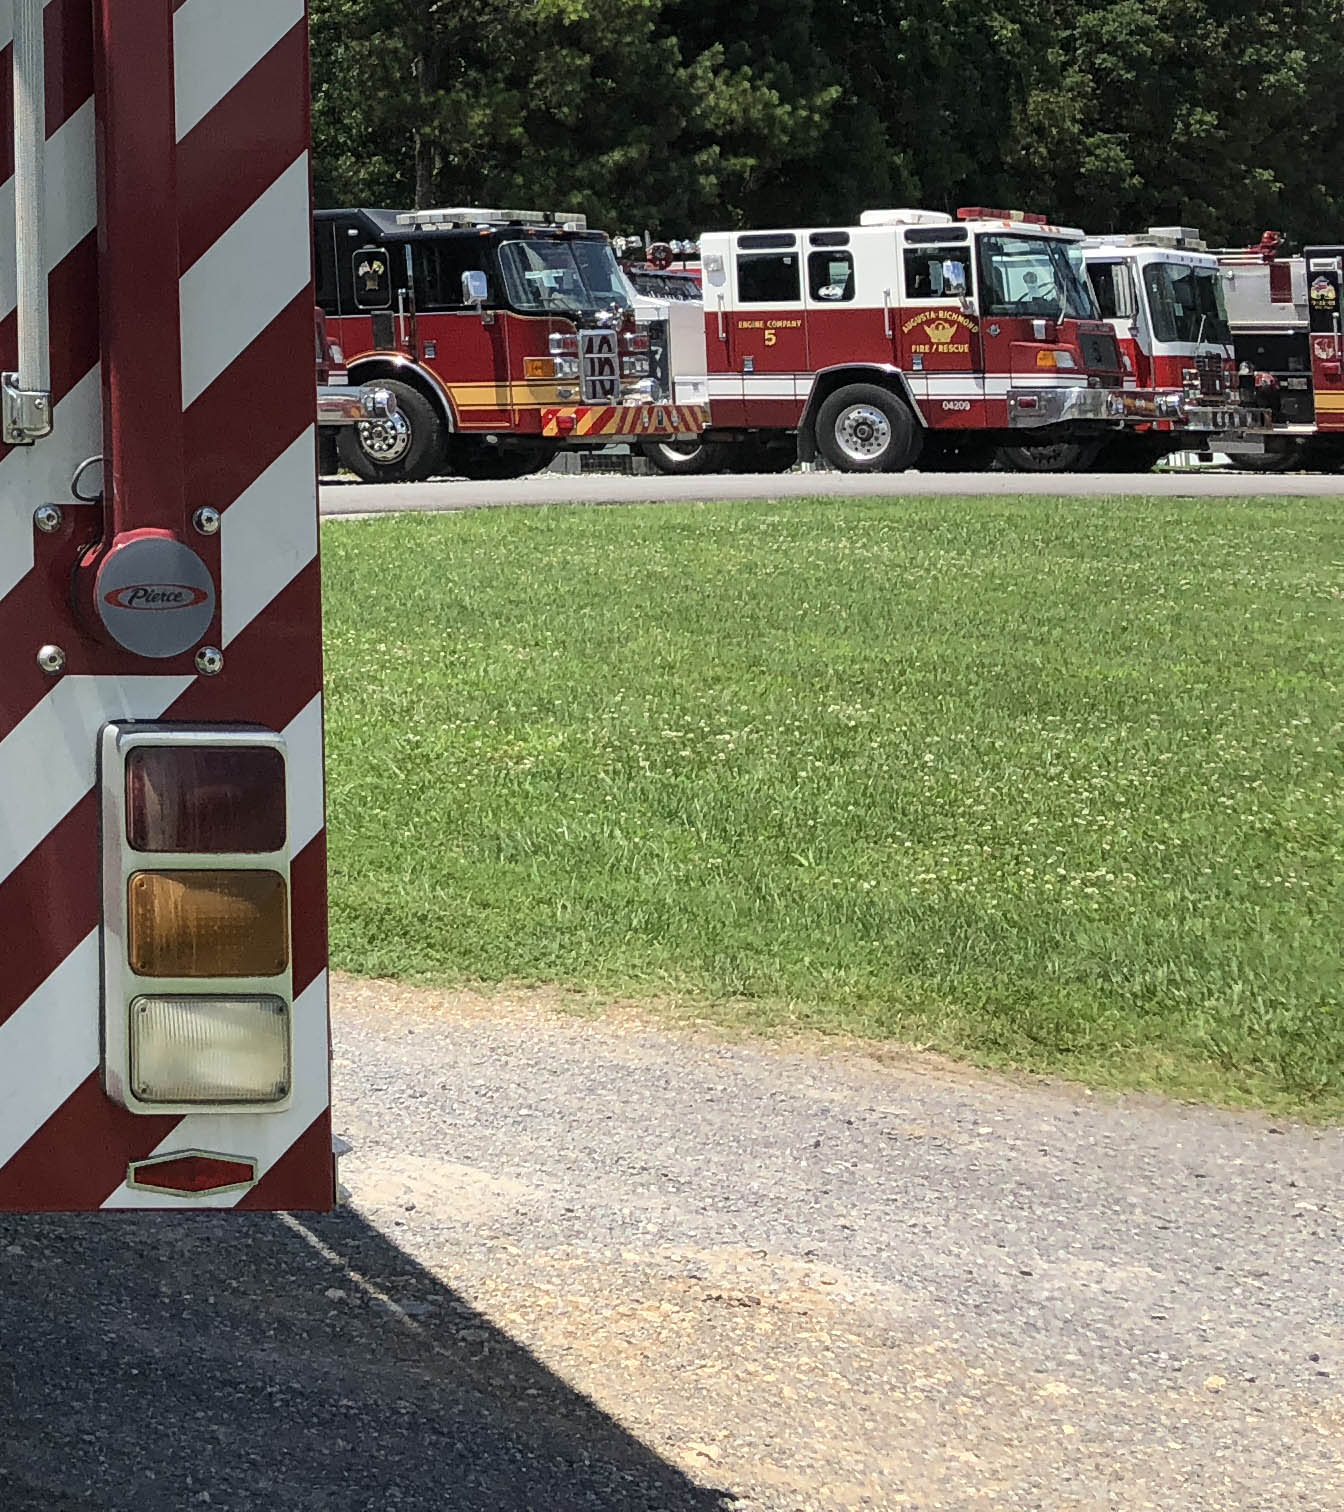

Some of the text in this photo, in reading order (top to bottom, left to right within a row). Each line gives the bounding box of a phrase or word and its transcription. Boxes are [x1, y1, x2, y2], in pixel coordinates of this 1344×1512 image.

[738, 319, 802, 328] ENGINE COMPANY
[902, 310, 979, 334] AUGUSTA-RICHMOND
[764, 329, 777, 346] 5
[911, 344, 930, 352] FIRE
[938, 344, 970, 353] RESCUE
[585, 334, 615, 400] 16
[127, 587, 185, 607] Pierce
